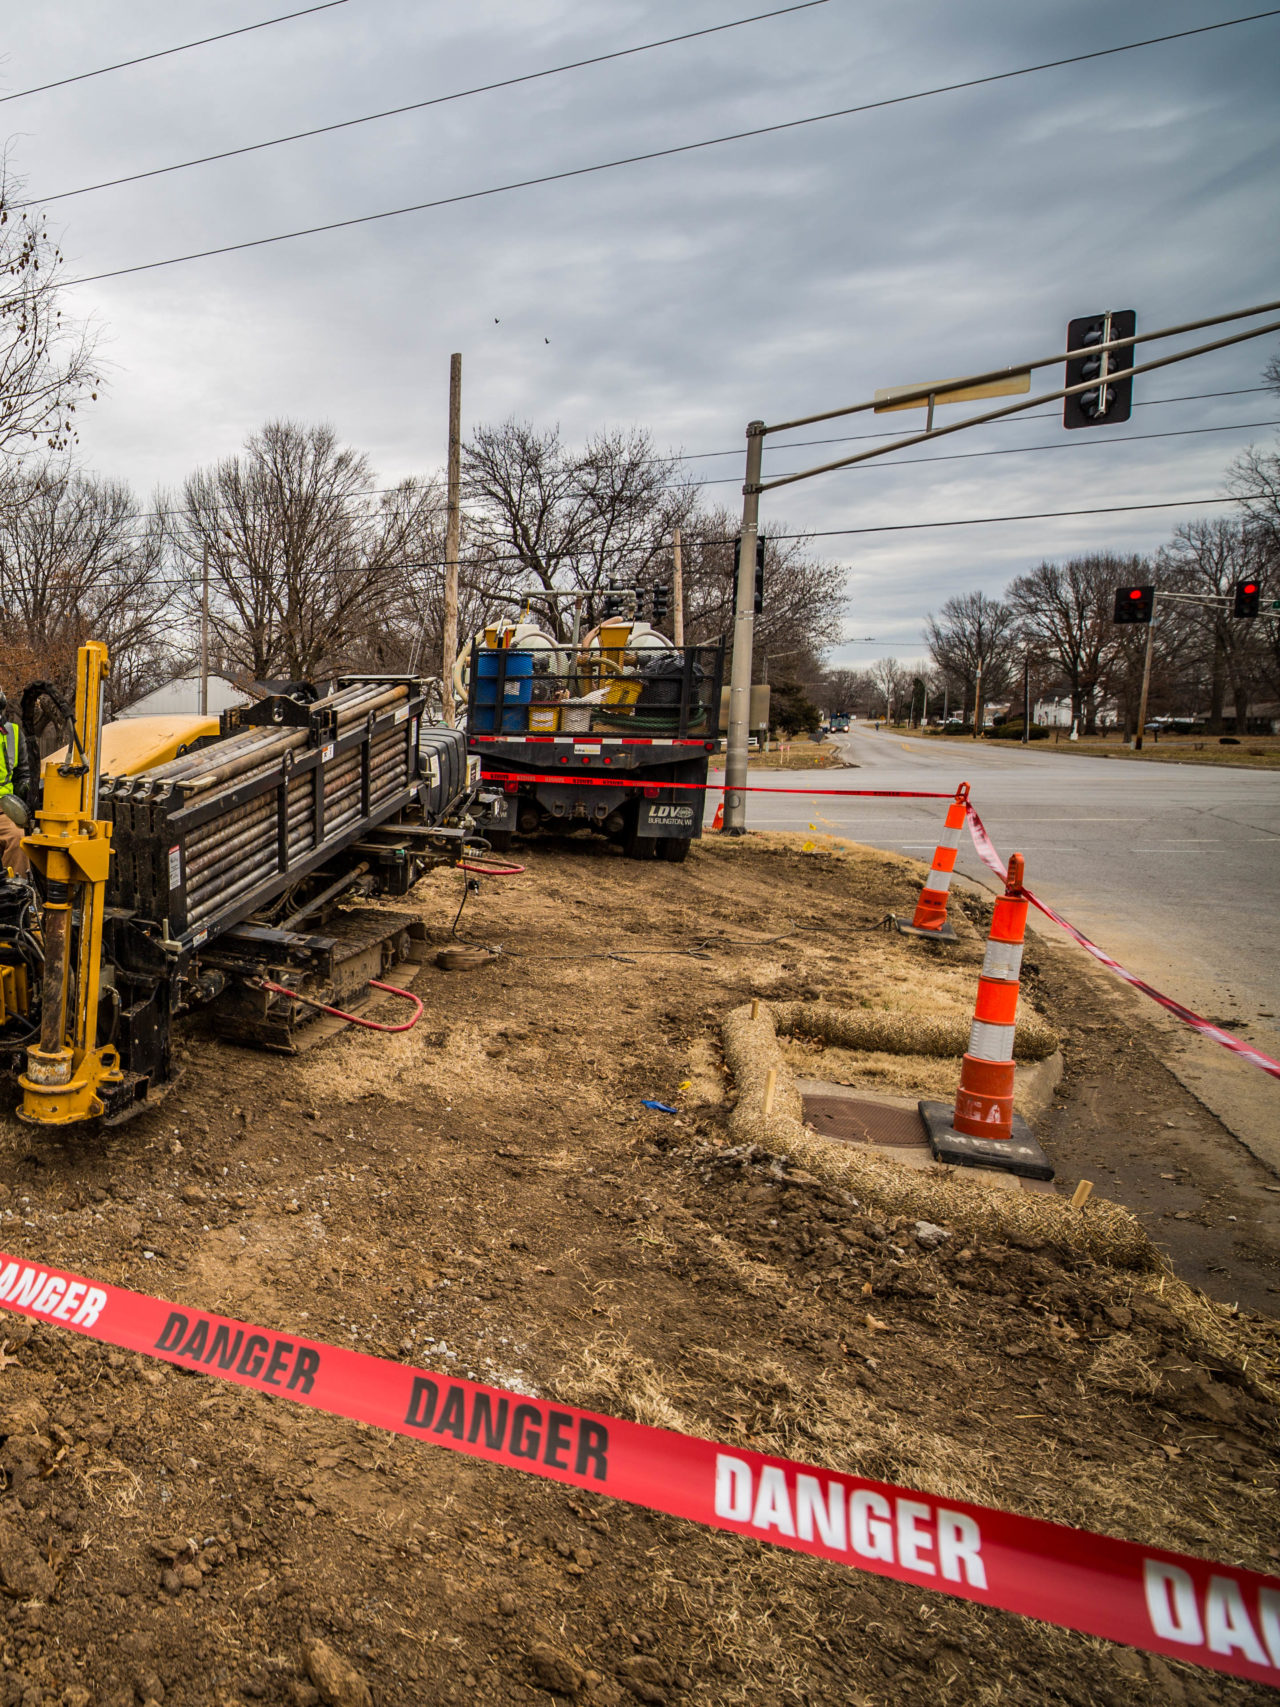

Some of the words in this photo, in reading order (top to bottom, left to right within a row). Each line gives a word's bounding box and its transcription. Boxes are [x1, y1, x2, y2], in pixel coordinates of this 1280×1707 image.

[649, 805, 680, 817] LDV
[154, 1312, 320, 1394] DANGER
[404, 1376, 609, 1481] DANGER
[715, 1454, 988, 1591] DANGER
